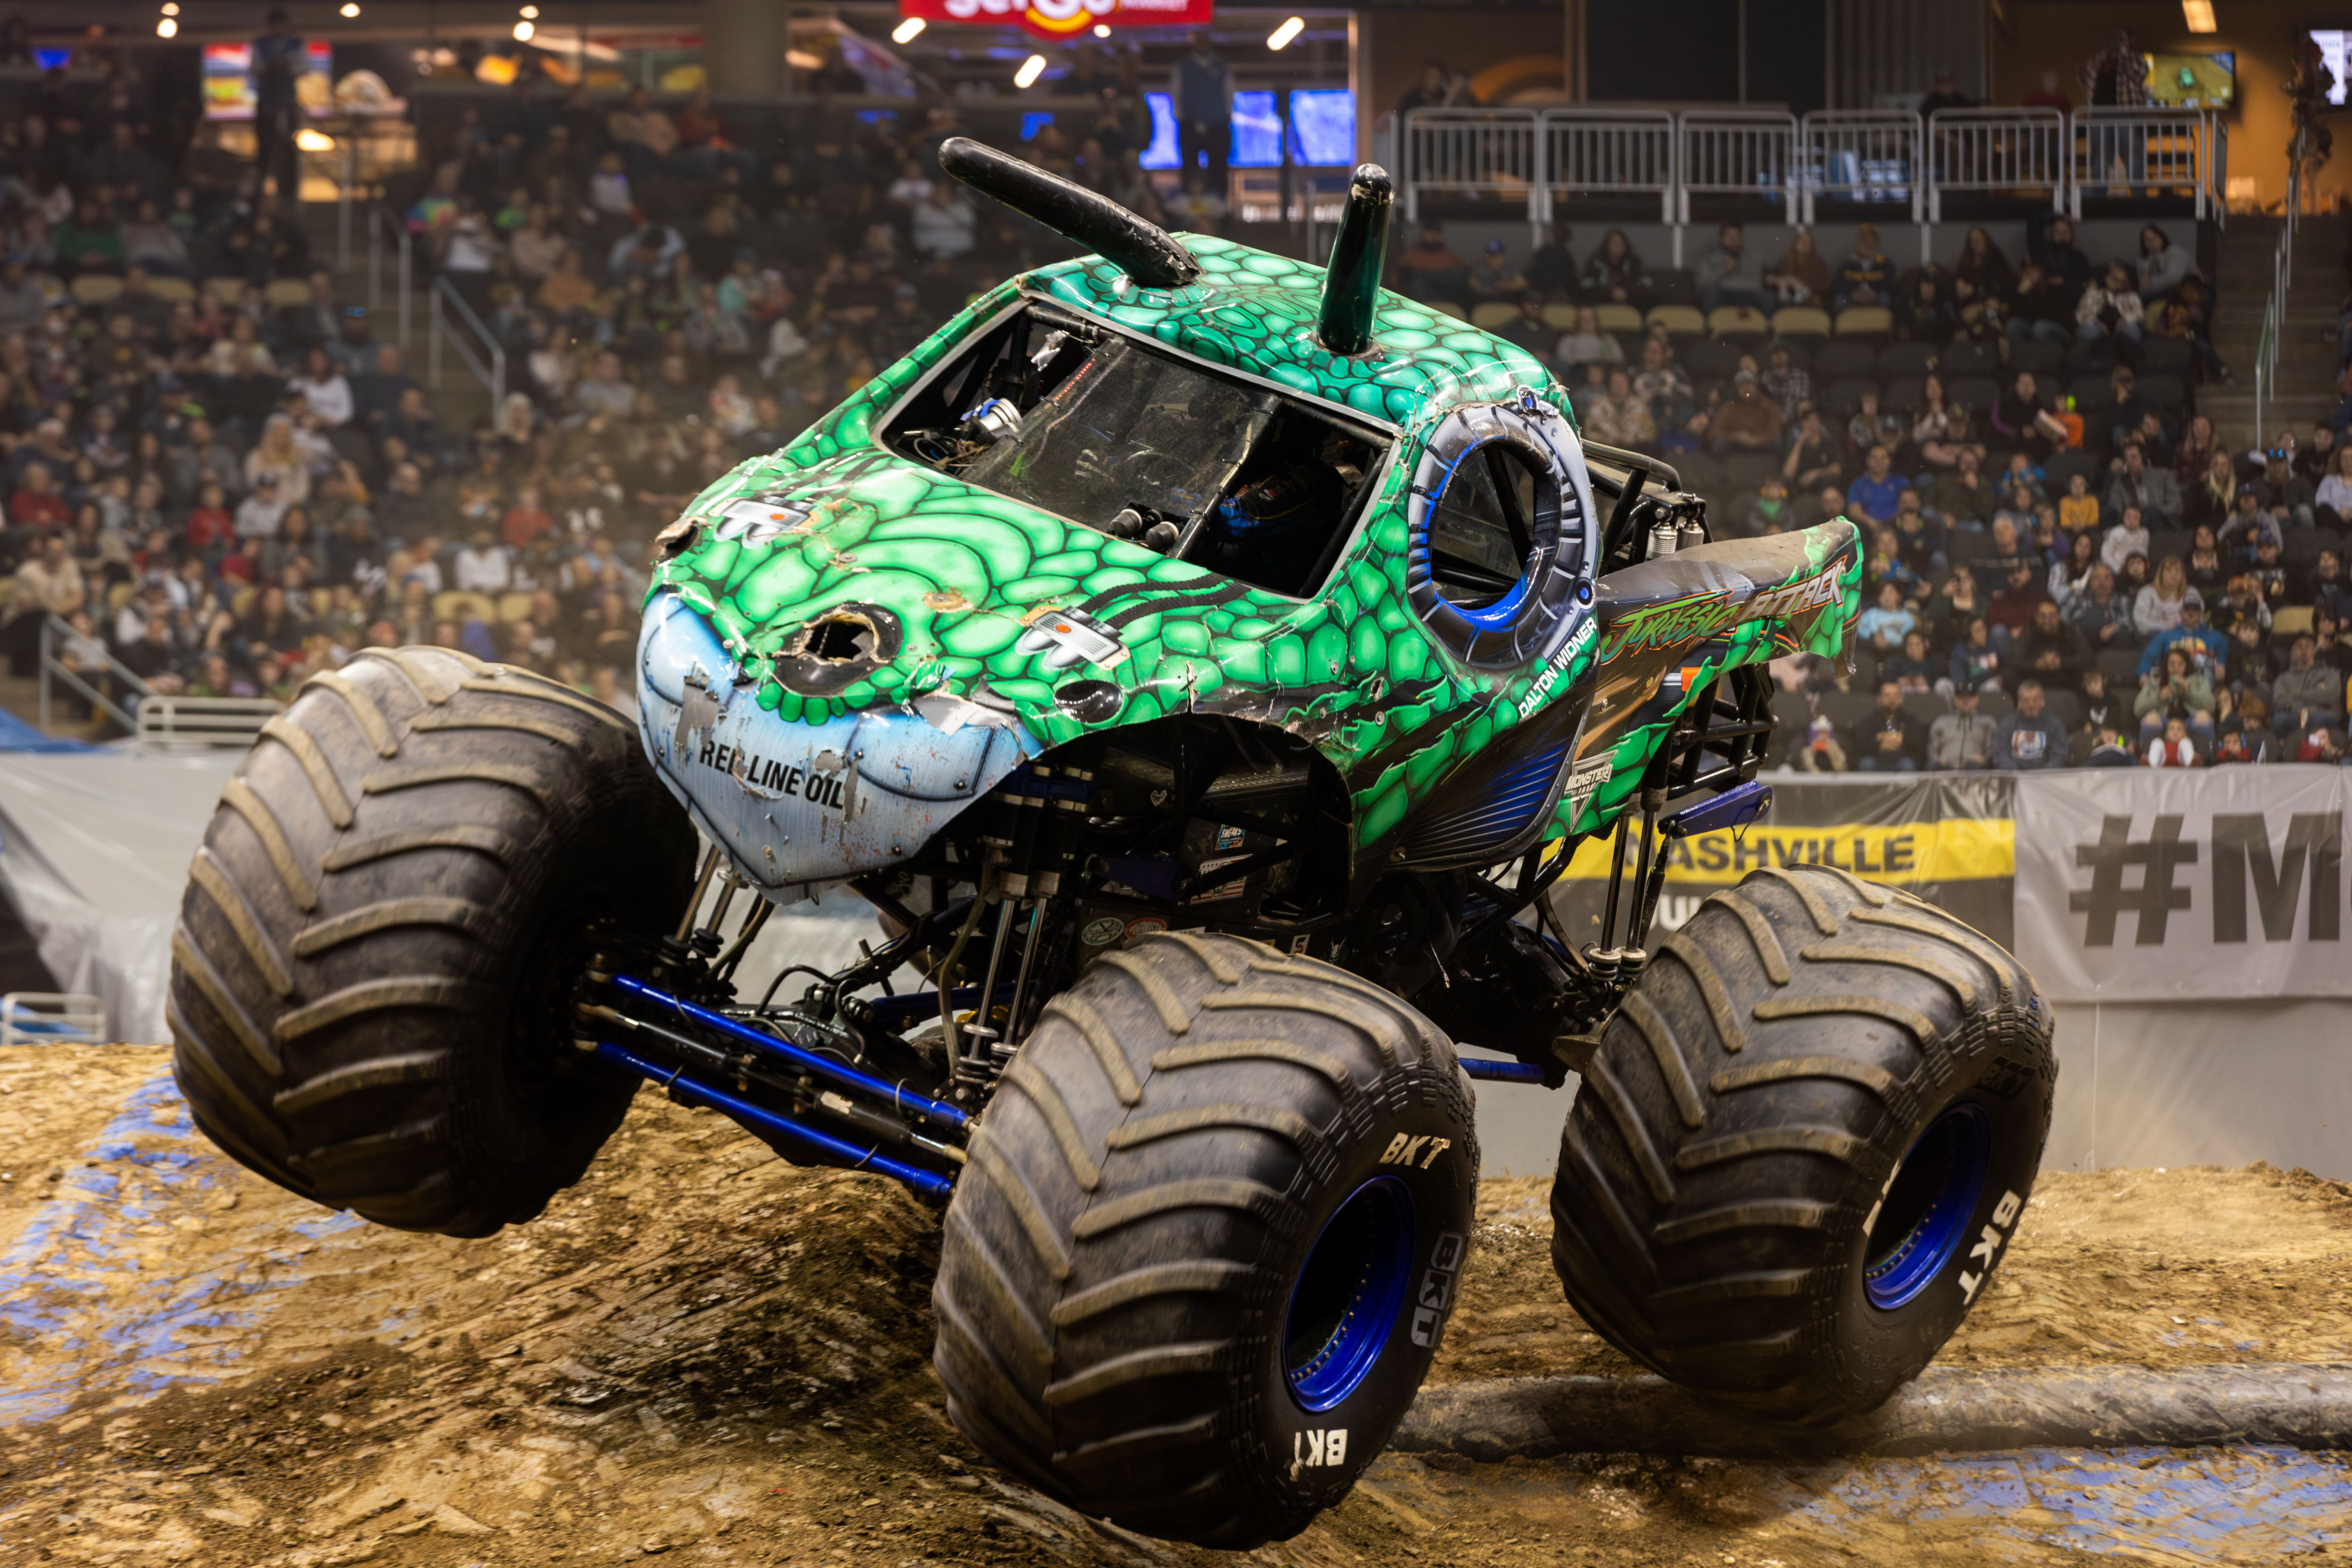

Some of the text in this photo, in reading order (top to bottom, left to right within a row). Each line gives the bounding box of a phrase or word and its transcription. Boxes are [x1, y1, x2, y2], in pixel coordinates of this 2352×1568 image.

[1600, 556, 1846, 664] JURASSIC ATTACK
[1518, 617, 1597, 719] DALTON WIDNER
[747, 755, 802, 796] LINE
[805, 774, 843, 810] OIL
[1565, 765, 1610, 791] MONSTER
[1626, 833, 1914, 871] NASHVILLE
[2069, 811, 2352, 948] #M
[1976, 1059, 2034, 1098] BKT
[1379, 1132, 1451, 1169] BKT
[1958, 1189, 2021, 1306] BKT
[1413, 1234, 1461, 1346] BKT
